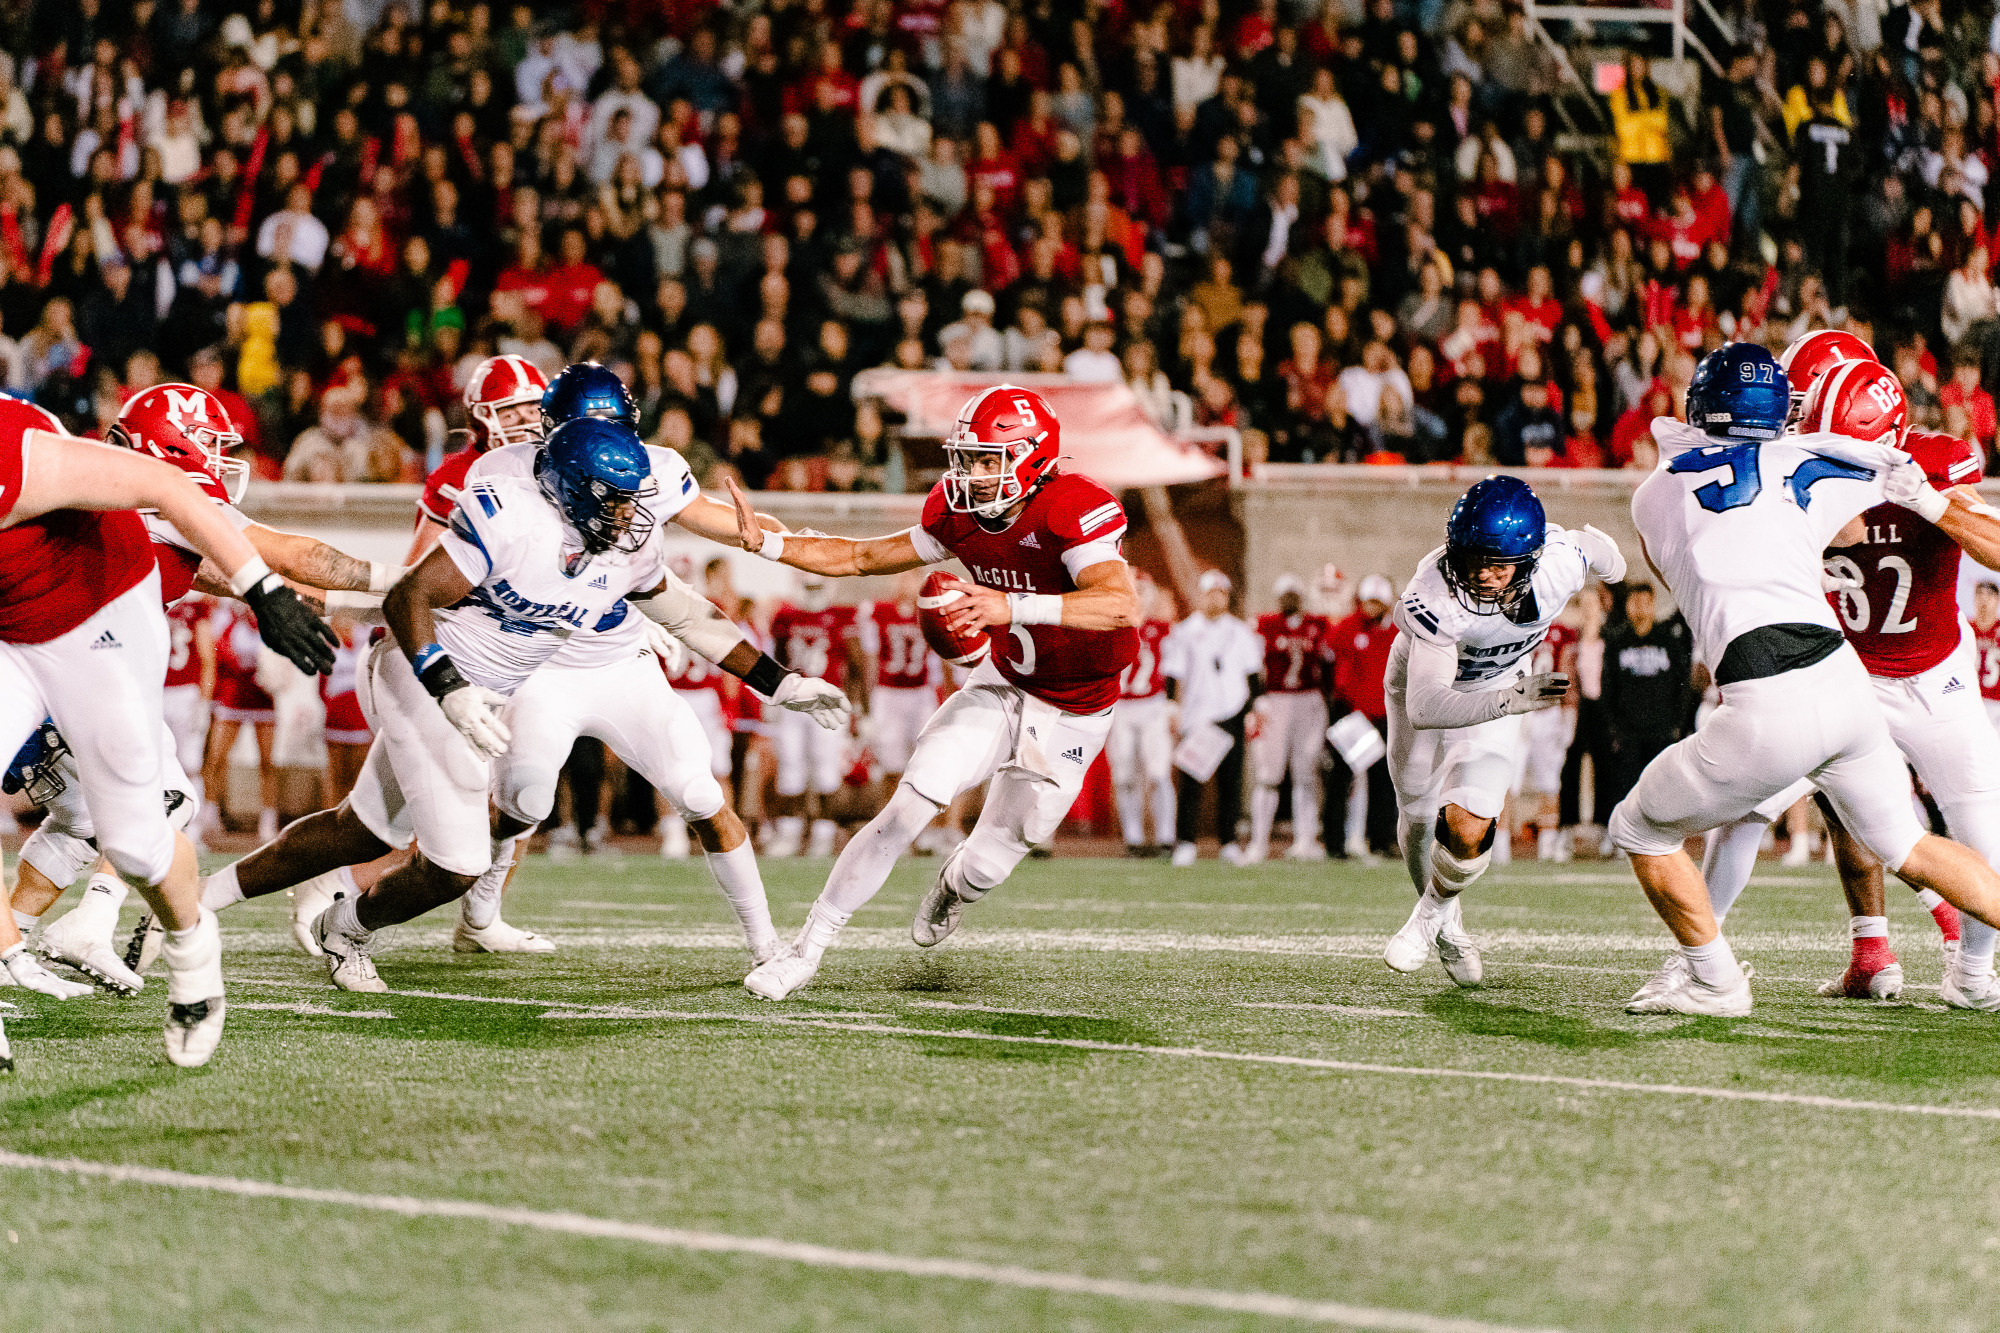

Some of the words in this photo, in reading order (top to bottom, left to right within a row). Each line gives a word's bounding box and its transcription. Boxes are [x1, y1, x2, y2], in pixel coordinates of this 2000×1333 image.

[1739, 362, 1774, 384] 97
[162, 389, 209, 423] M
[1867, 376, 1902, 413] 82
[1012, 399, 1037, 427] 5
[1018, 540, 1042, 550] adidas
[1823, 555, 1918, 634] 82
[1061, 752, 1083, 765] adidas
